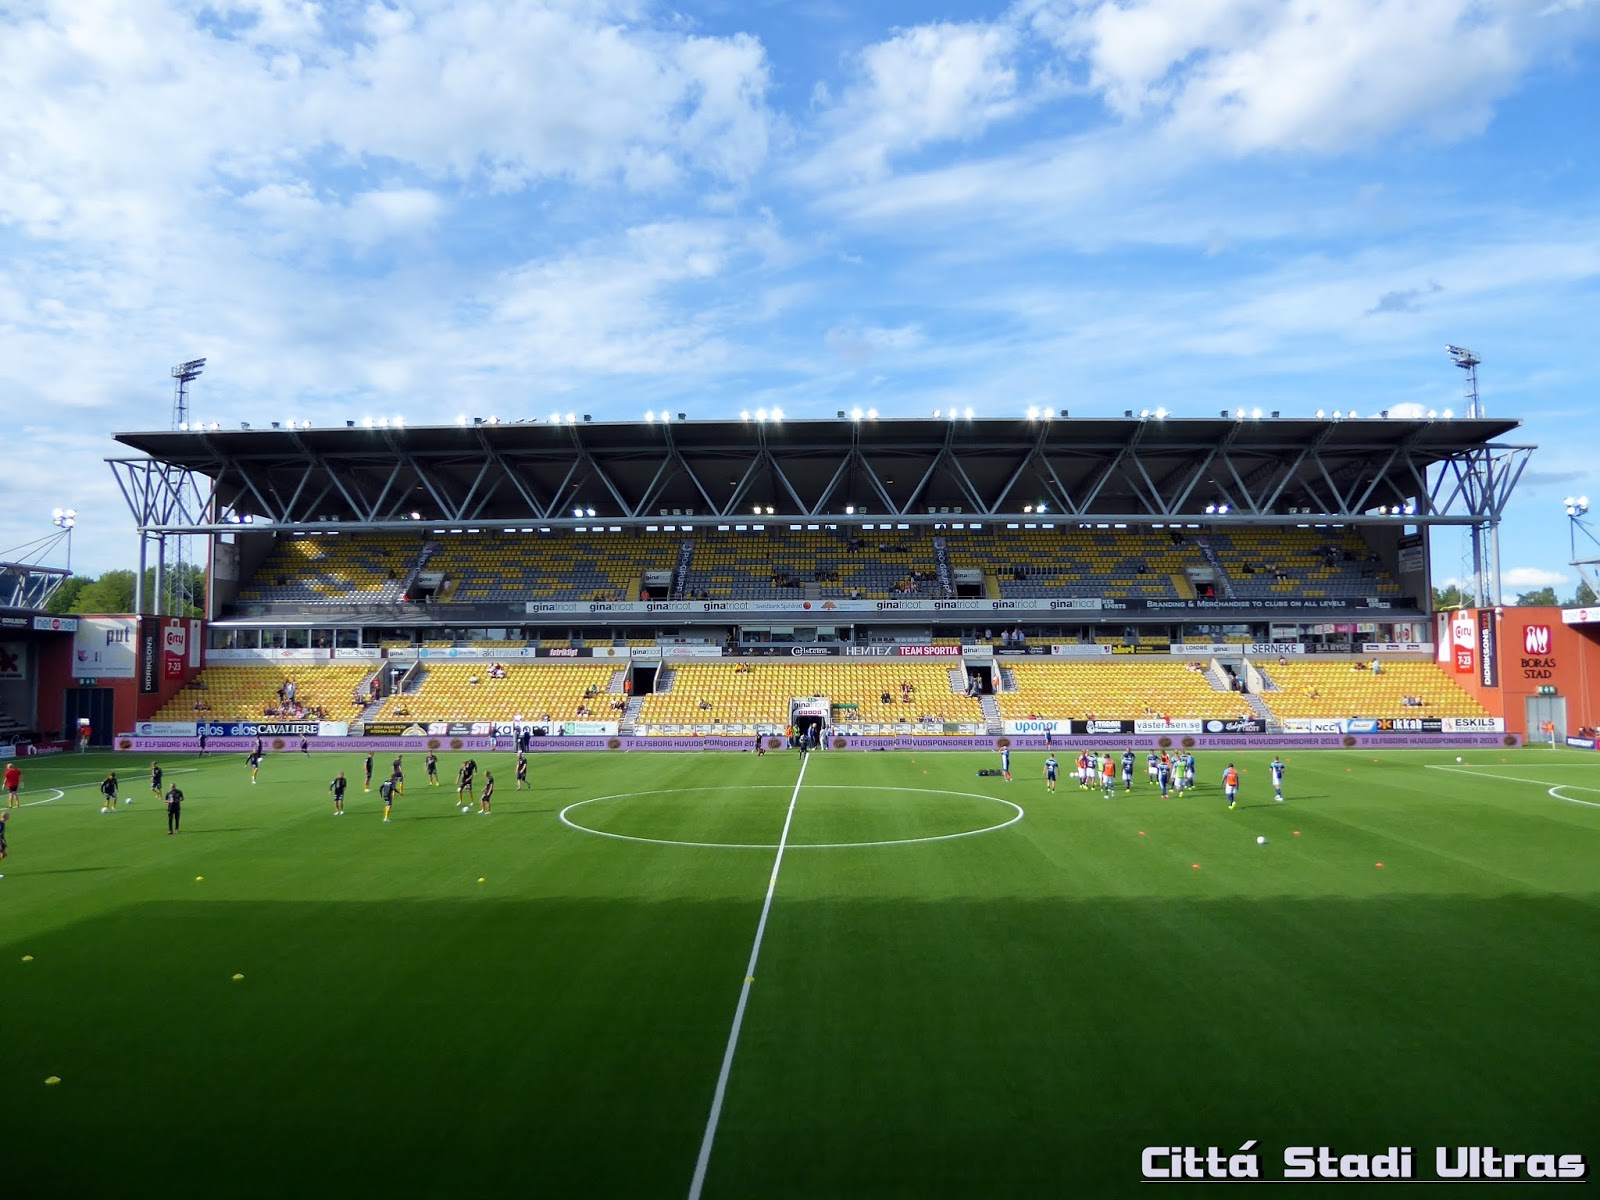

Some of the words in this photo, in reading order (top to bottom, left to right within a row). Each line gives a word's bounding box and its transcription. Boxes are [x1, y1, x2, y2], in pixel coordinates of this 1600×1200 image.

[106, 626, 130, 646] put
[846, 647, 892, 656] HEMTEX
[900, 647, 924, 655] TEAM
[924, 646, 959, 655] SPORTIA
[1251, 644, 1297, 653] SERNEKE
[1482, 629, 1491, 685] DIDRIKSONS
[145, 636, 153, 691] DIDRIKSONS
[1524, 670, 1552, 679] STAD
[1455, 718, 1495, 726] ESKILS
[197, 723, 224, 736] ellos
[231, 723, 258, 736] ellos
[258, 724, 318, 734] CAVALIERE
